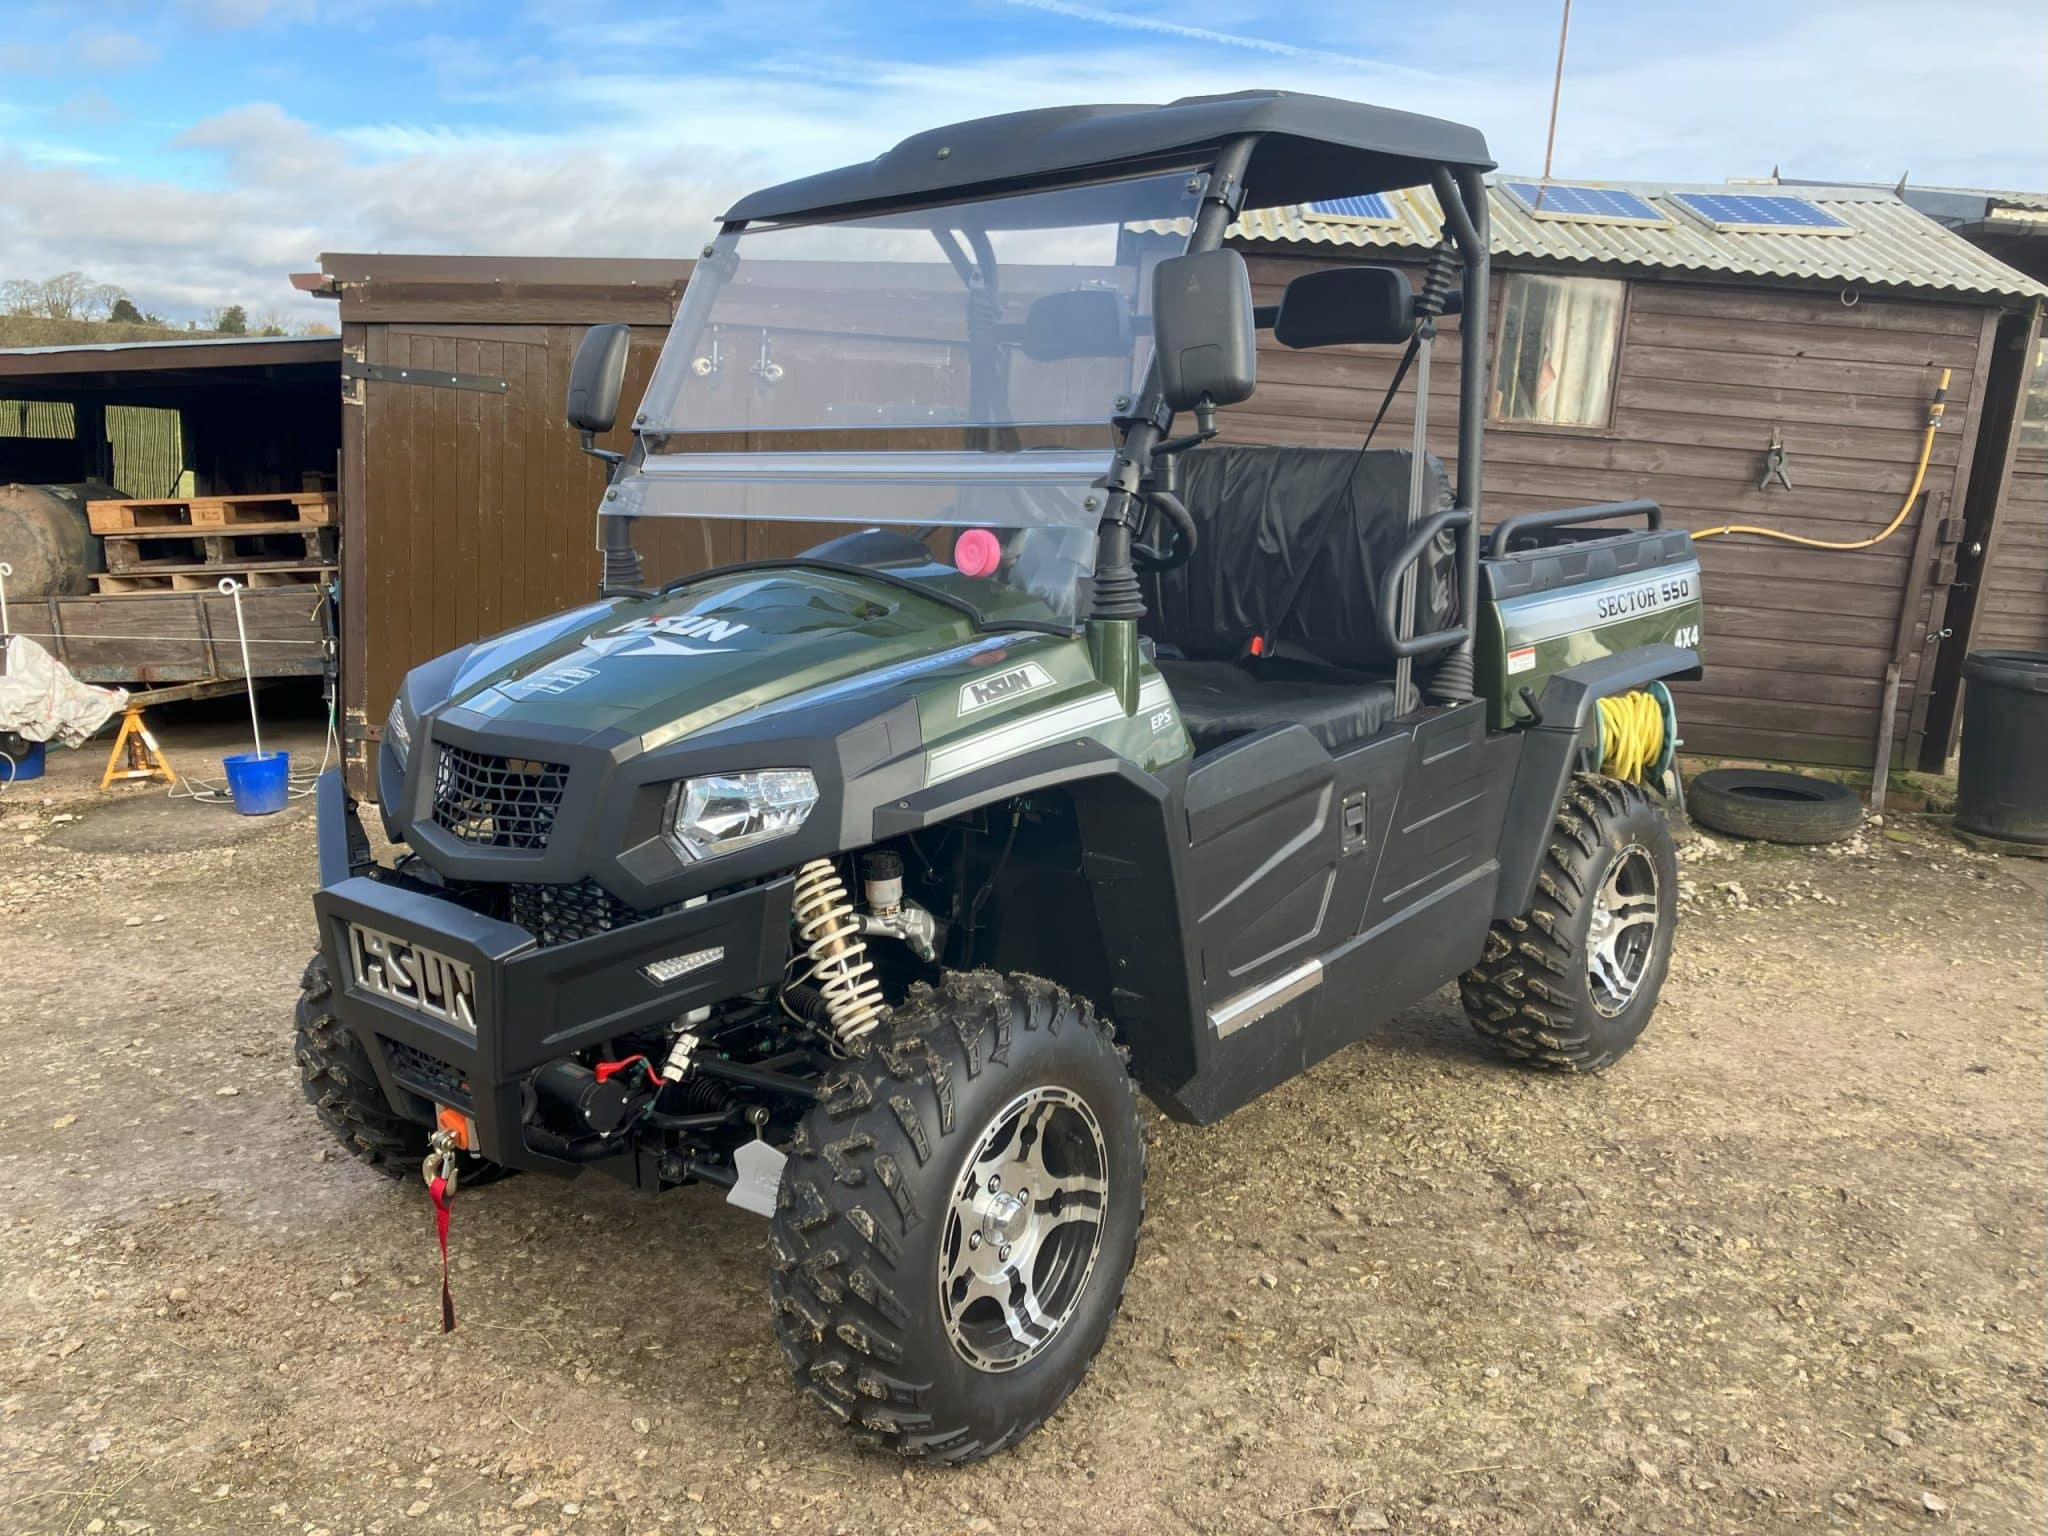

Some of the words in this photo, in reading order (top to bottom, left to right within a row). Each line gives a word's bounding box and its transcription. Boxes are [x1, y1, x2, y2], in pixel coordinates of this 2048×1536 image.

[1598, 587, 1657, 618] SECTOR
[1662, 580, 1689, 601] 550
[1674, 624, 1699, 648] 4X4
[1150, 708, 1172, 731] EPS
